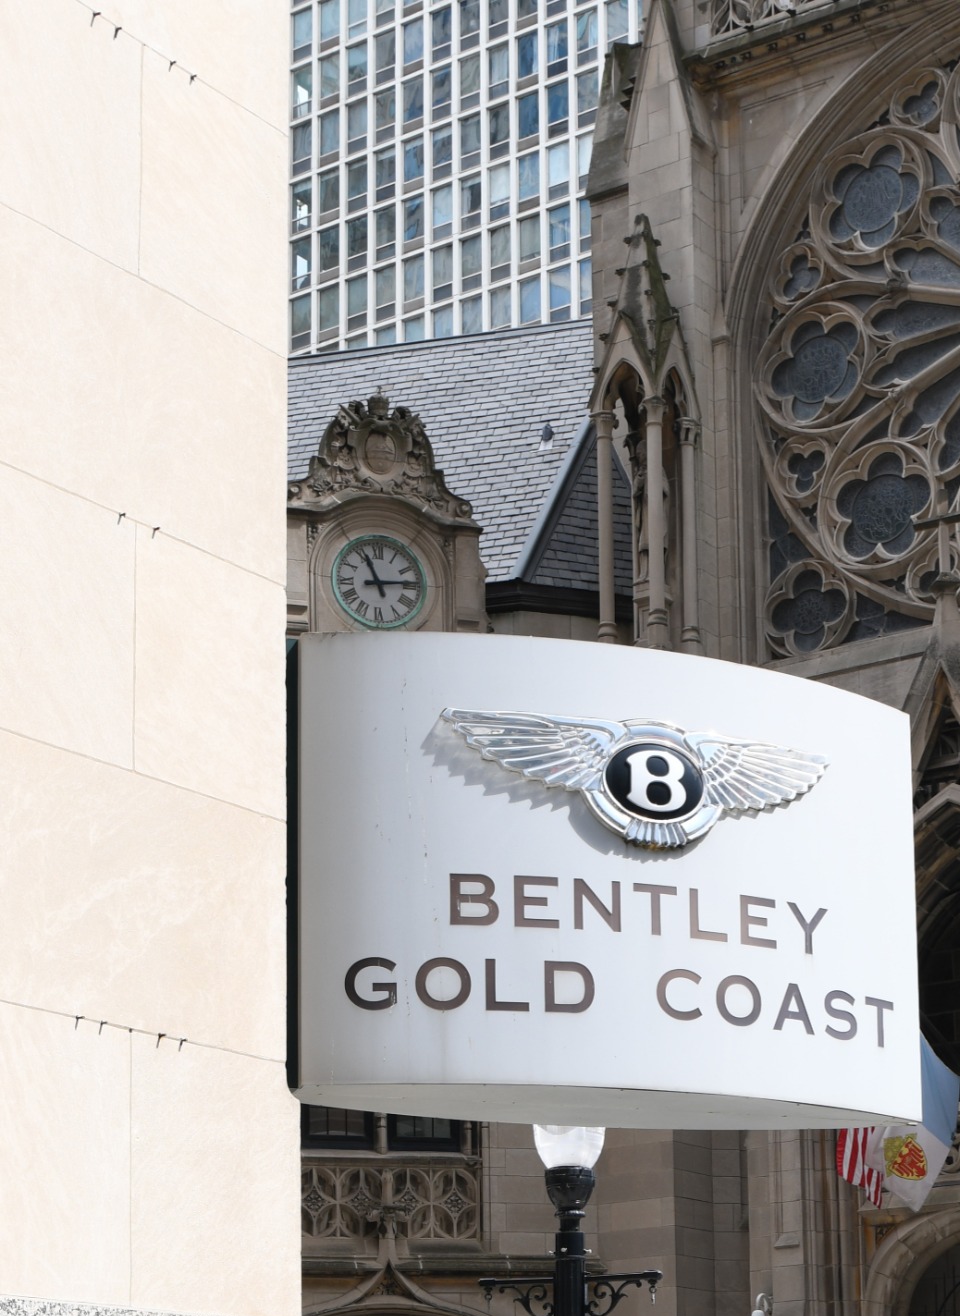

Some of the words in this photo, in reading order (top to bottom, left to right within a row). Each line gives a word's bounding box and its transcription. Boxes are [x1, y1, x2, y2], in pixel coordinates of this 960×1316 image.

[624, 749, 688, 813] B
[449, 872, 828, 955] BENTLEY
[344, 956, 596, 1014] GOLD
[656, 968, 895, 1048] COAST
